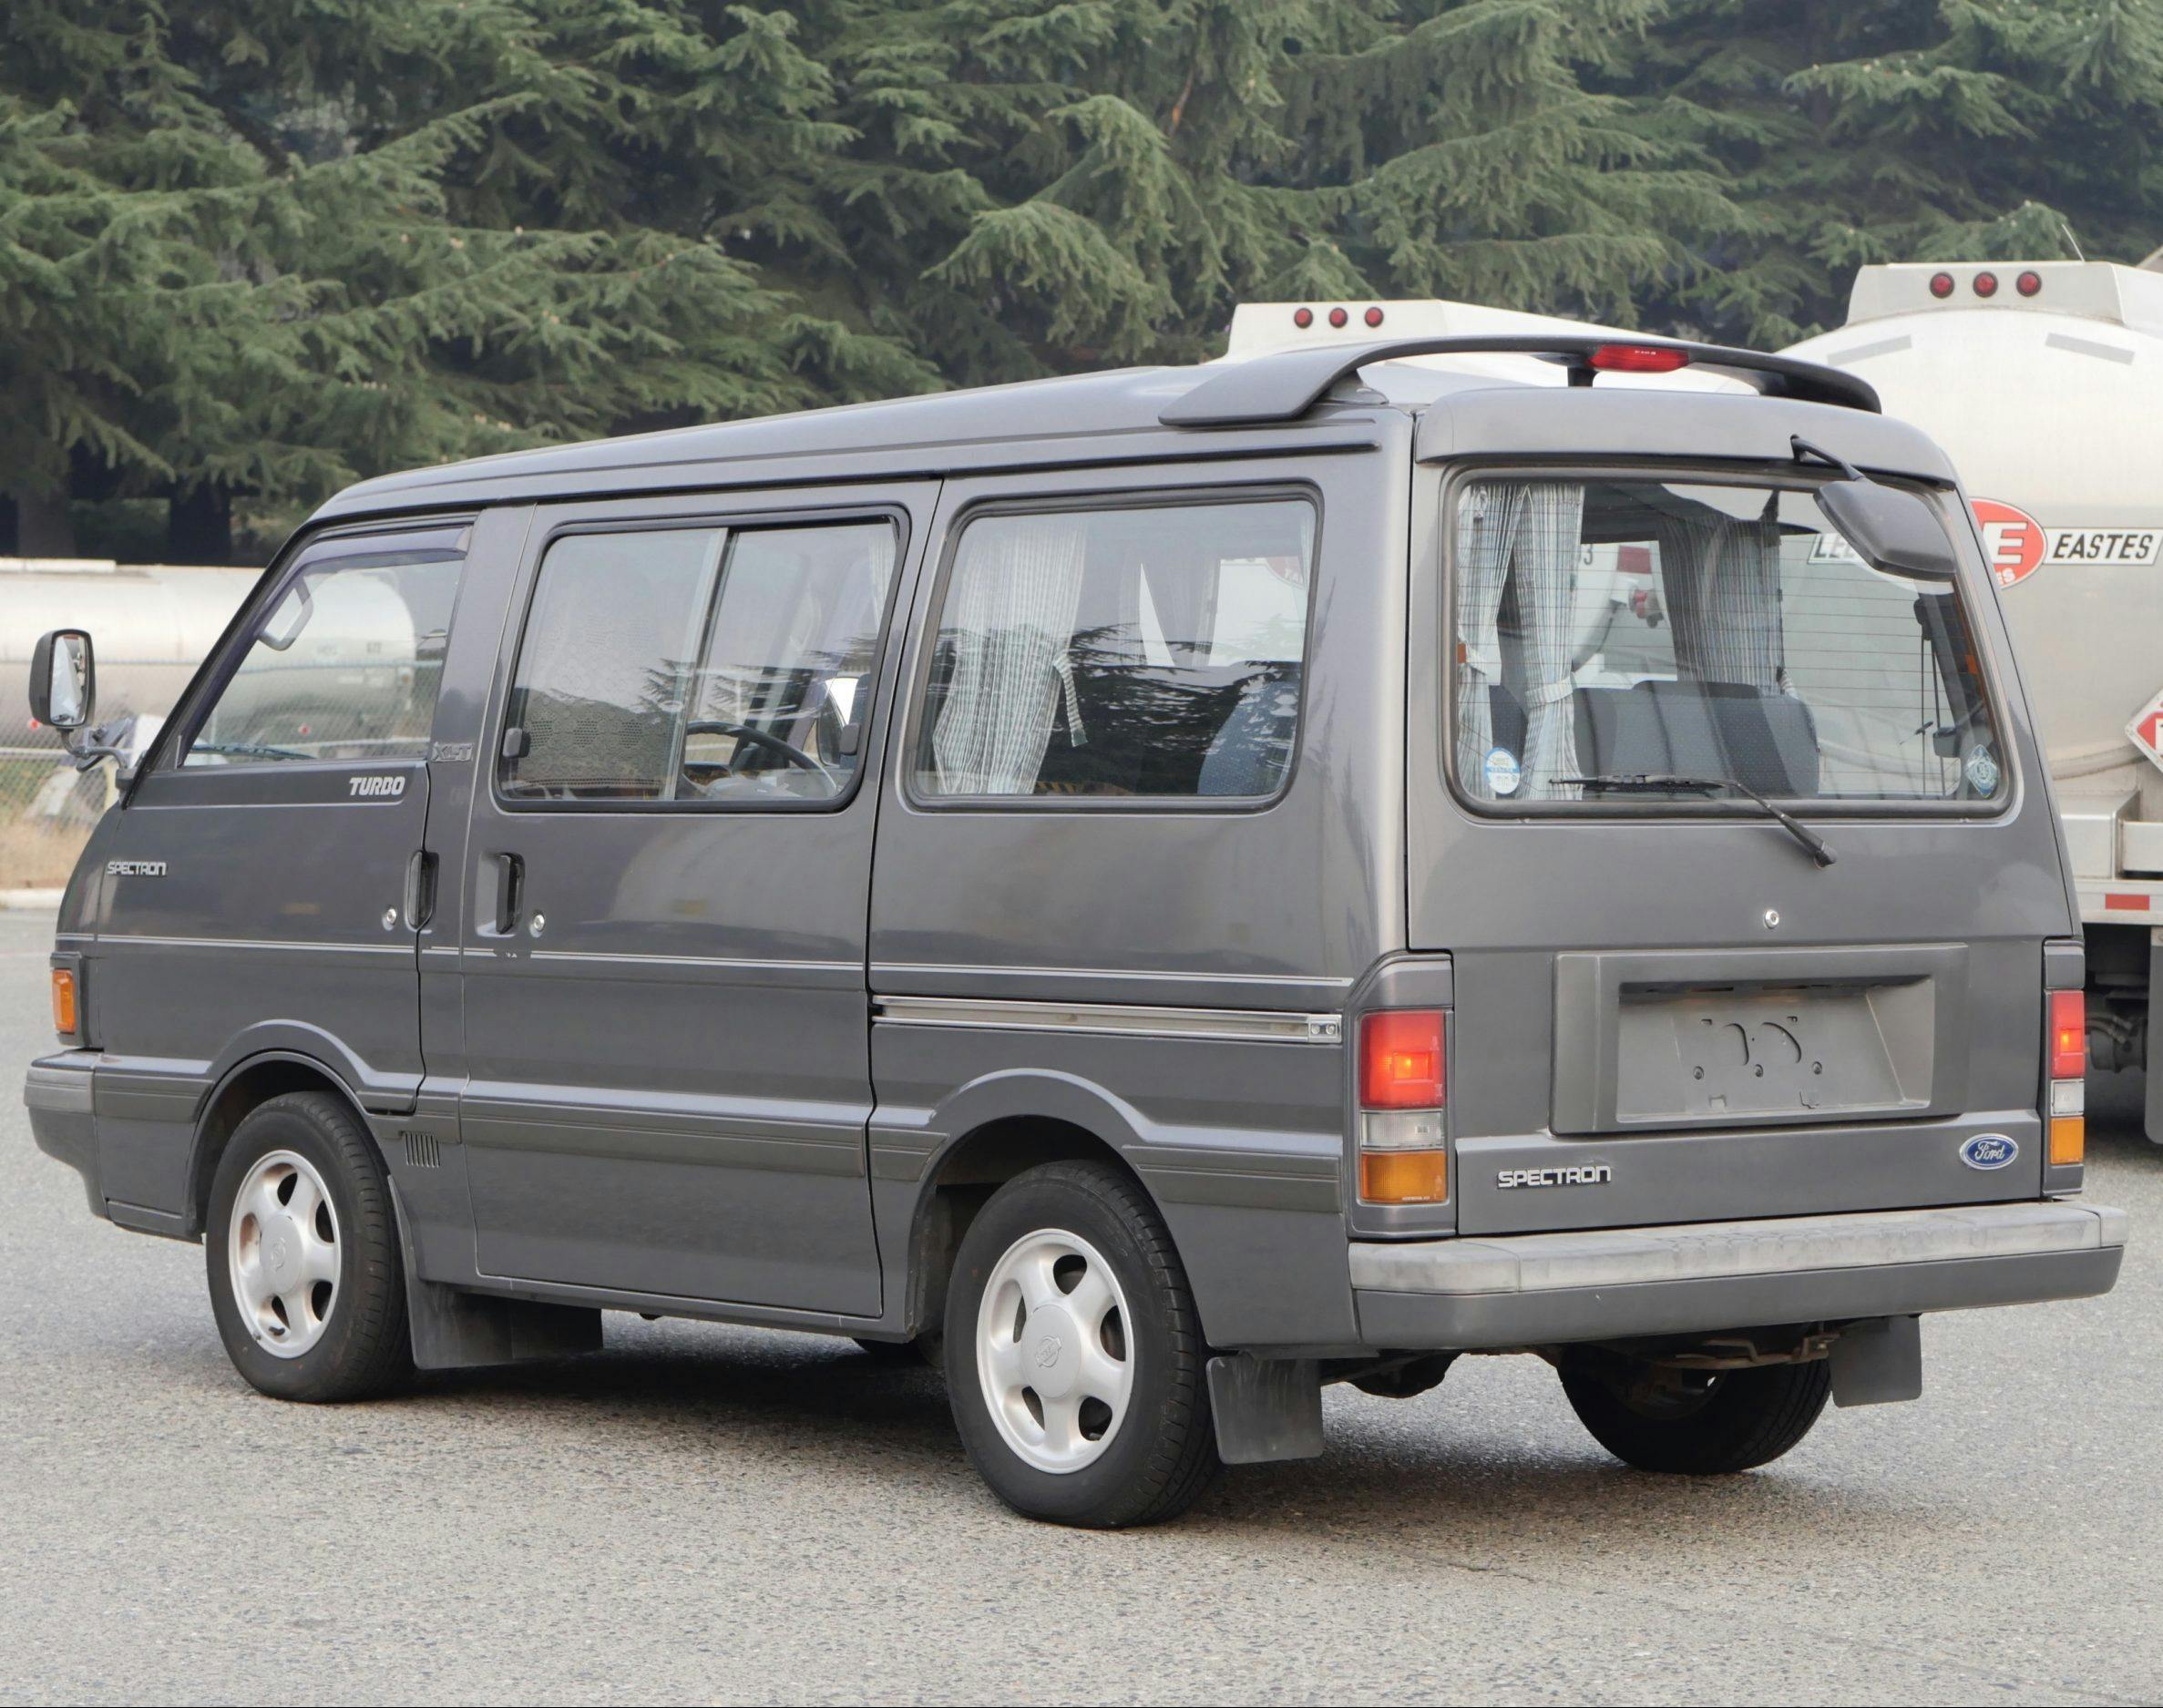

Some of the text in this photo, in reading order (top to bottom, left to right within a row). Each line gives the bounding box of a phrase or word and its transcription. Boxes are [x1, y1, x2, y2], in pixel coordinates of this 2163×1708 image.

[1982, 521, 2028, 564] E
[2052, 533, 2153, 559] EASTES
[430, 741, 473, 762] XLT
[349, 776, 405, 796] TURBO
[108, 861, 167, 876] SPECTRON
[1974, 1140, 2005, 1161] Ford
[1497, 1165, 1612, 1189] SPECTRON
